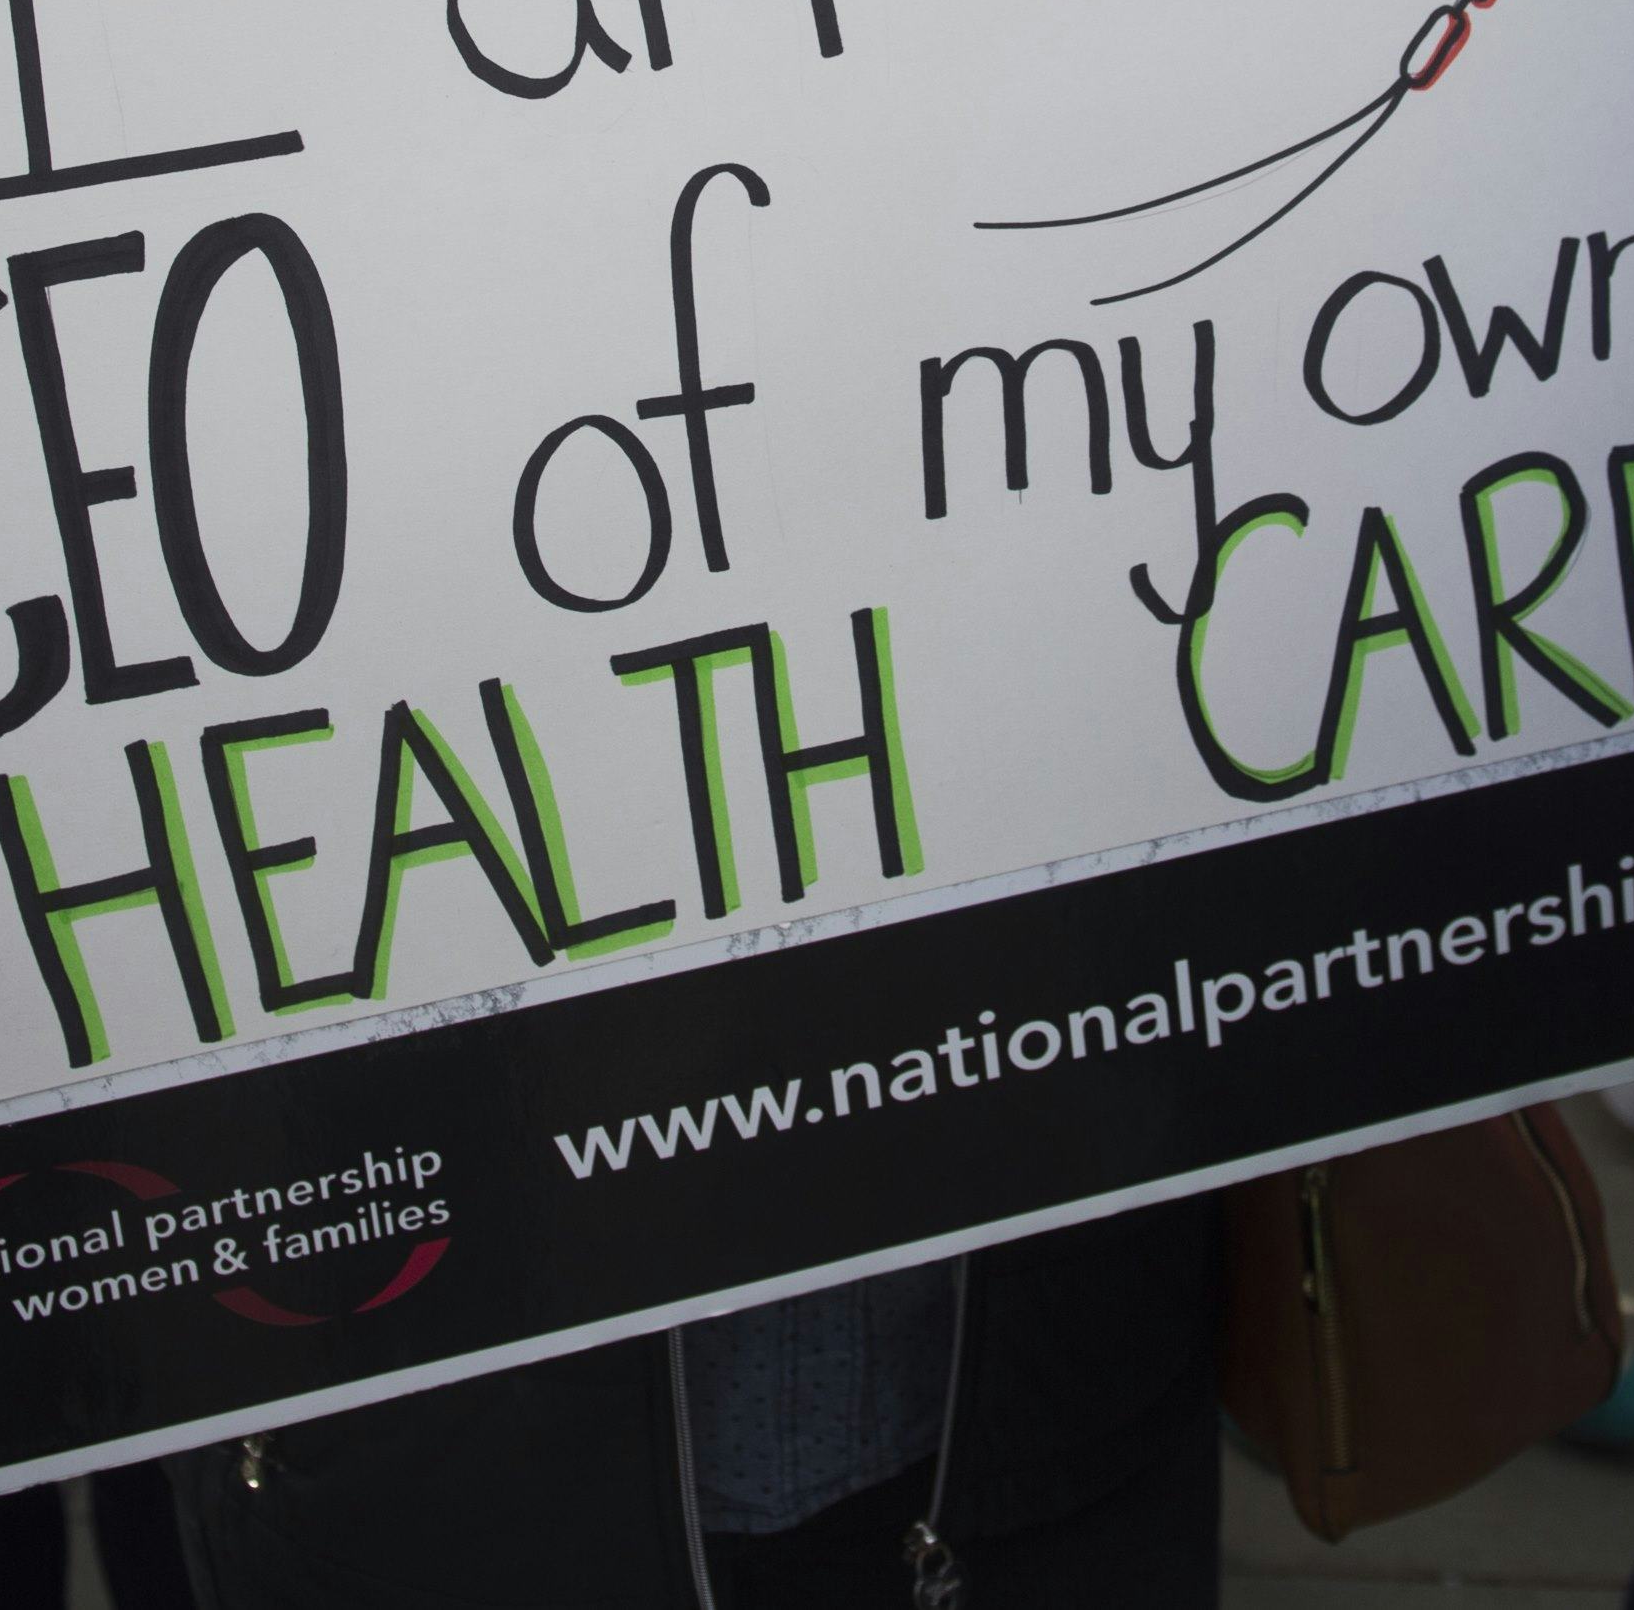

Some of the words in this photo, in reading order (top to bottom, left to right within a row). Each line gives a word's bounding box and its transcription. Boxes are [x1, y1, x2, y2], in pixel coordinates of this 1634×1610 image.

[512, 162, 771, 613] of
[919, 319, 1217, 625] my
[11, 1256, 200, 1322] women
[211, 1236, 250, 1277] &
[262, 1197, 453, 1264] families
[144, 1145, 444, 1252] partnership
